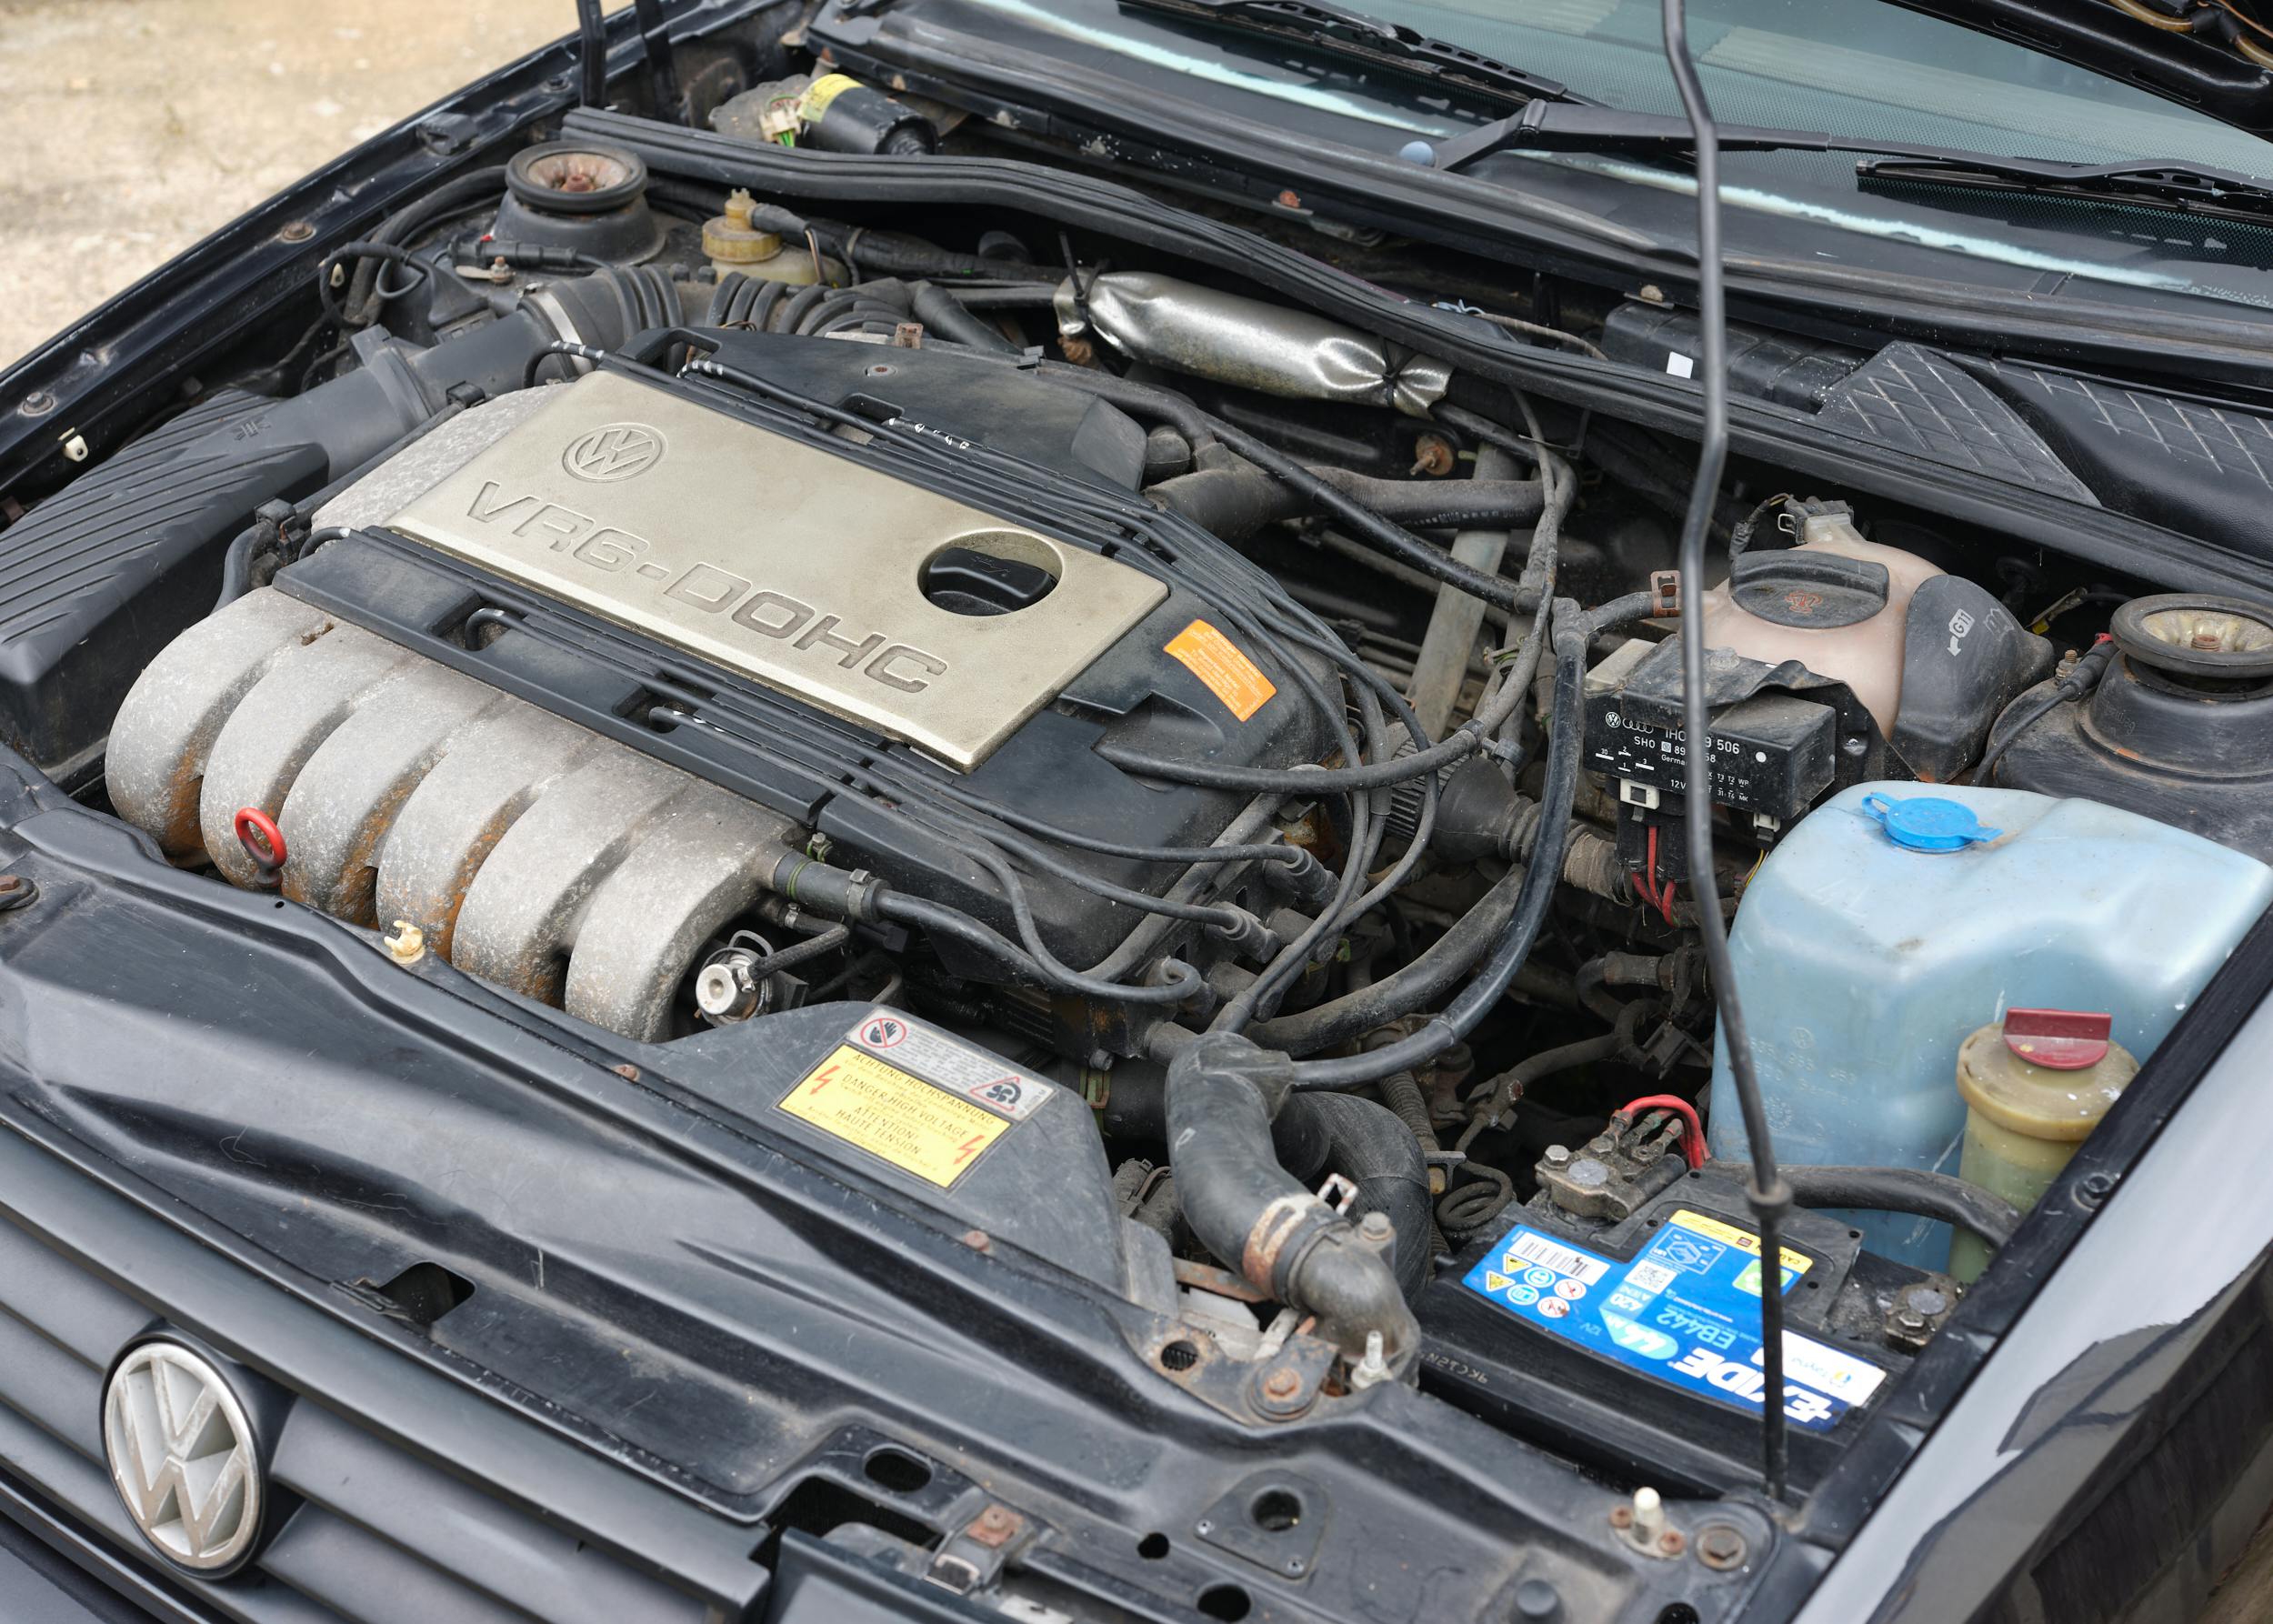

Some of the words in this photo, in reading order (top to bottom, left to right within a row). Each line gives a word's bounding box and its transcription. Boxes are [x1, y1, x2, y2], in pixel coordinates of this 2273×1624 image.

[466, 479, 949, 695] VR6-DOHC
[1953, 612, 1972, 635] G11
[1600, 747, 1608, 756] 30
[1661, 754, 1687, 766] Germa
[1717, 738, 1740, 755] 506
[1670, 779, 1687, 789] 12V
[850, 1052, 906, 1081] ACHTUNG
[903, 1077, 997, 1125] HOCHSPANNUNG
[852, 1105, 921, 1141] ATTENTION!
[886, 1094, 919, 1114] HIGH
[916, 1109, 970, 1138] VOLTAGE
[834, 1108, 873, 1131] HAUTE
[871, 1127, 923, 1155] TENSION
[1609, 1293, 1643, 1311] 420
[1620, 1324, 1667, 1353] 44
[1656, 1307, 1737, 1350] EB442
